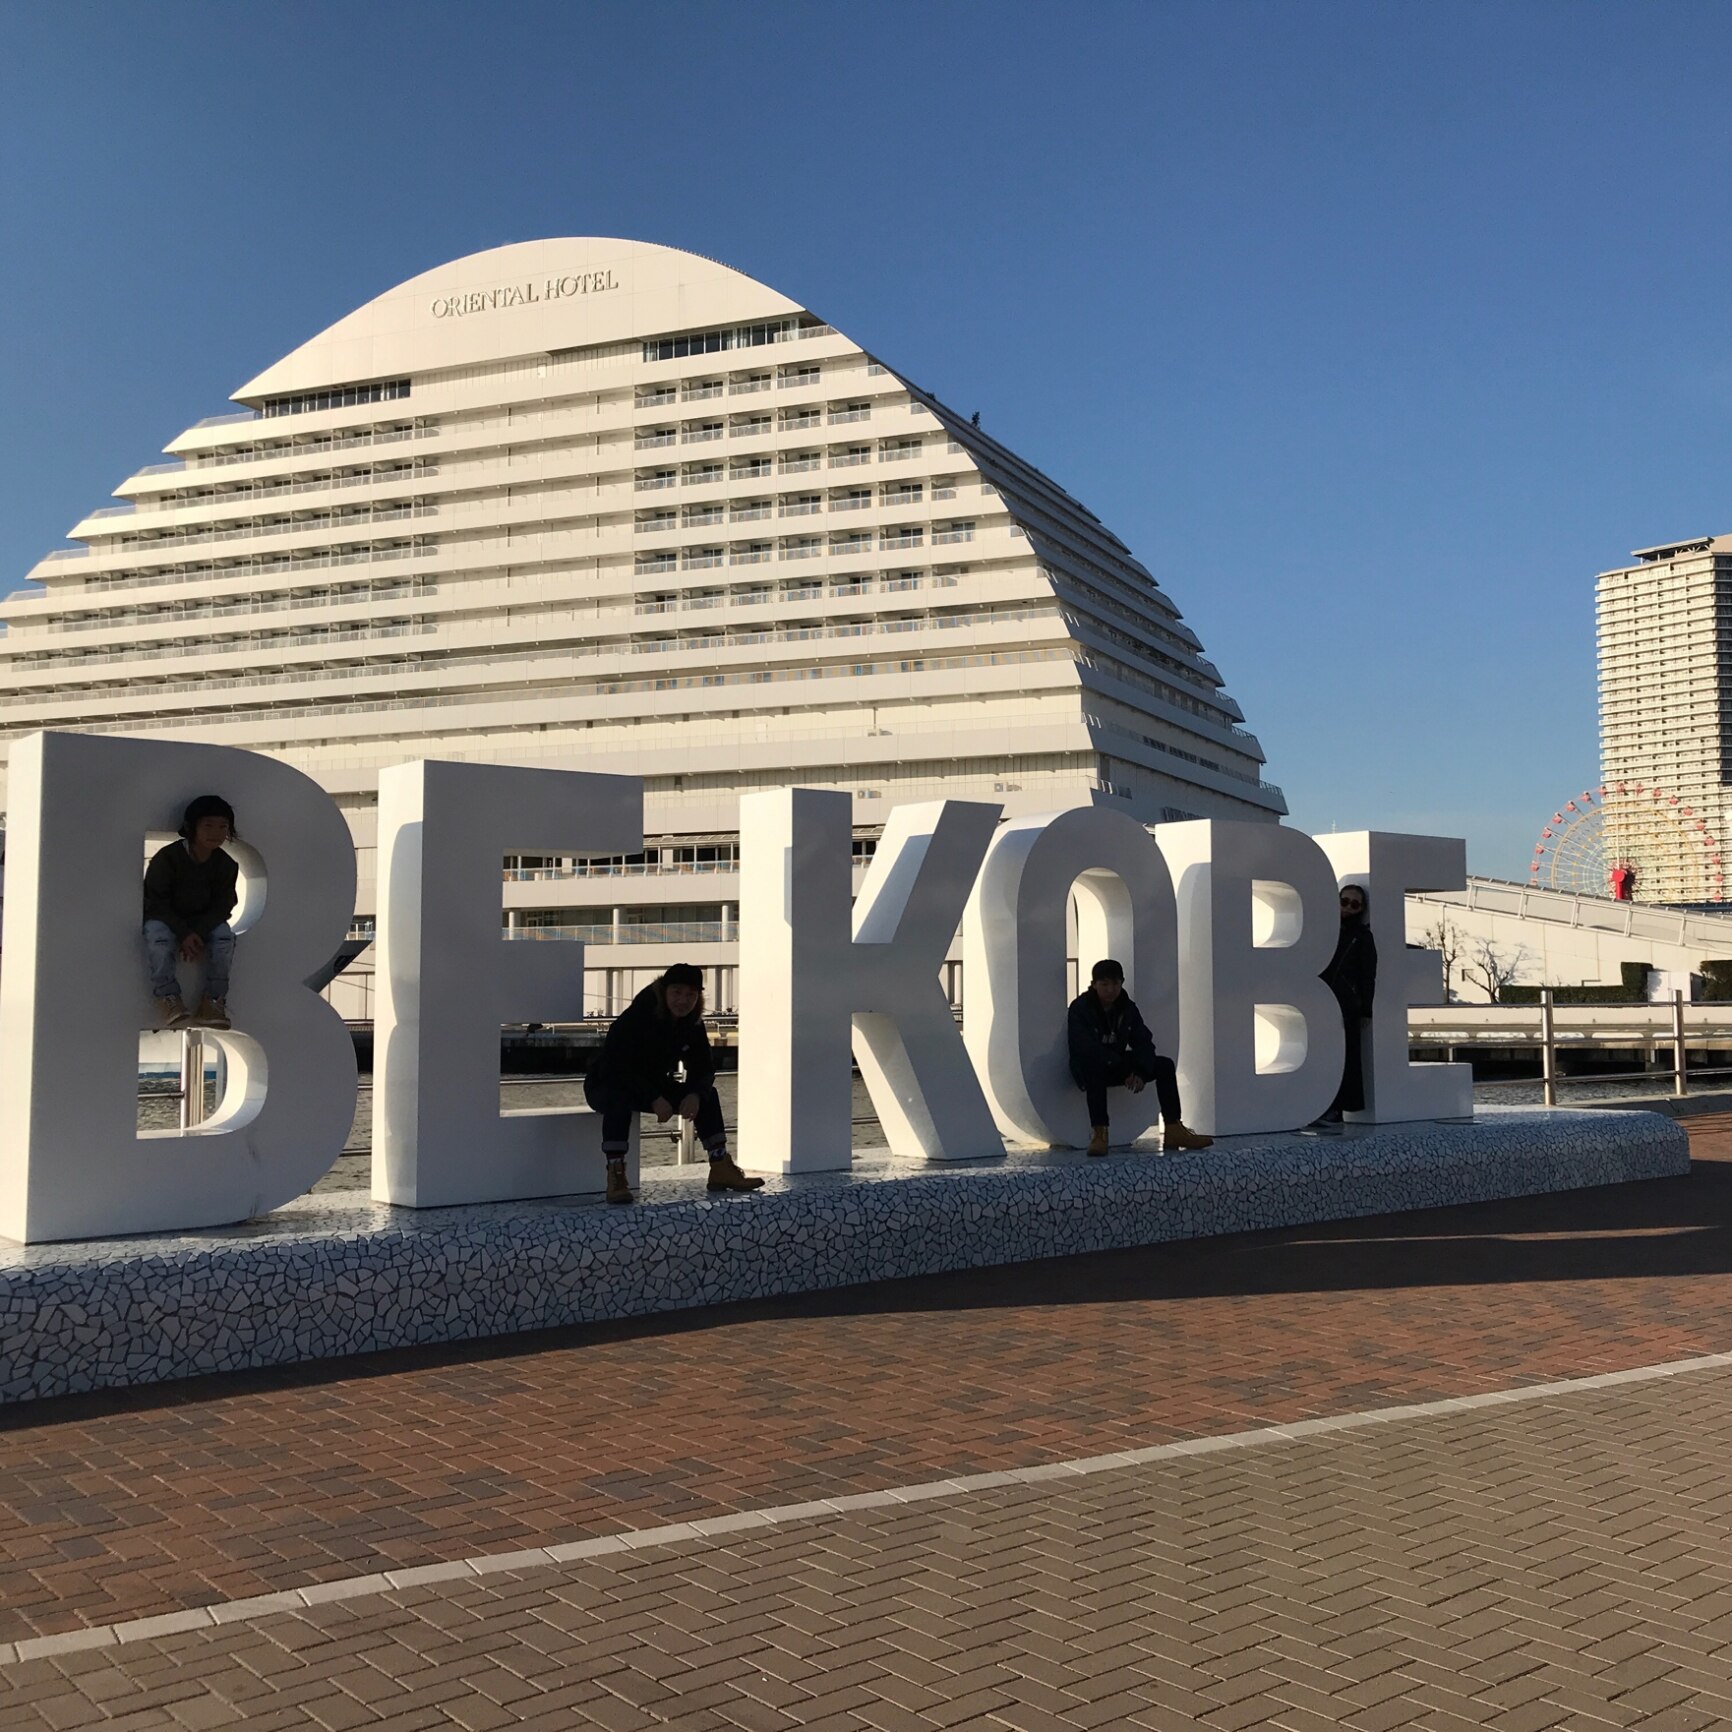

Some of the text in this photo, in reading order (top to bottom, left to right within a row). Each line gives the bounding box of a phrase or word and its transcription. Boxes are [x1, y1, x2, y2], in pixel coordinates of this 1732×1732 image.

[431, 269, 619, 319] ORIENTAL HOTEL
[0, 731, 1474, 1245] BE KOBE
